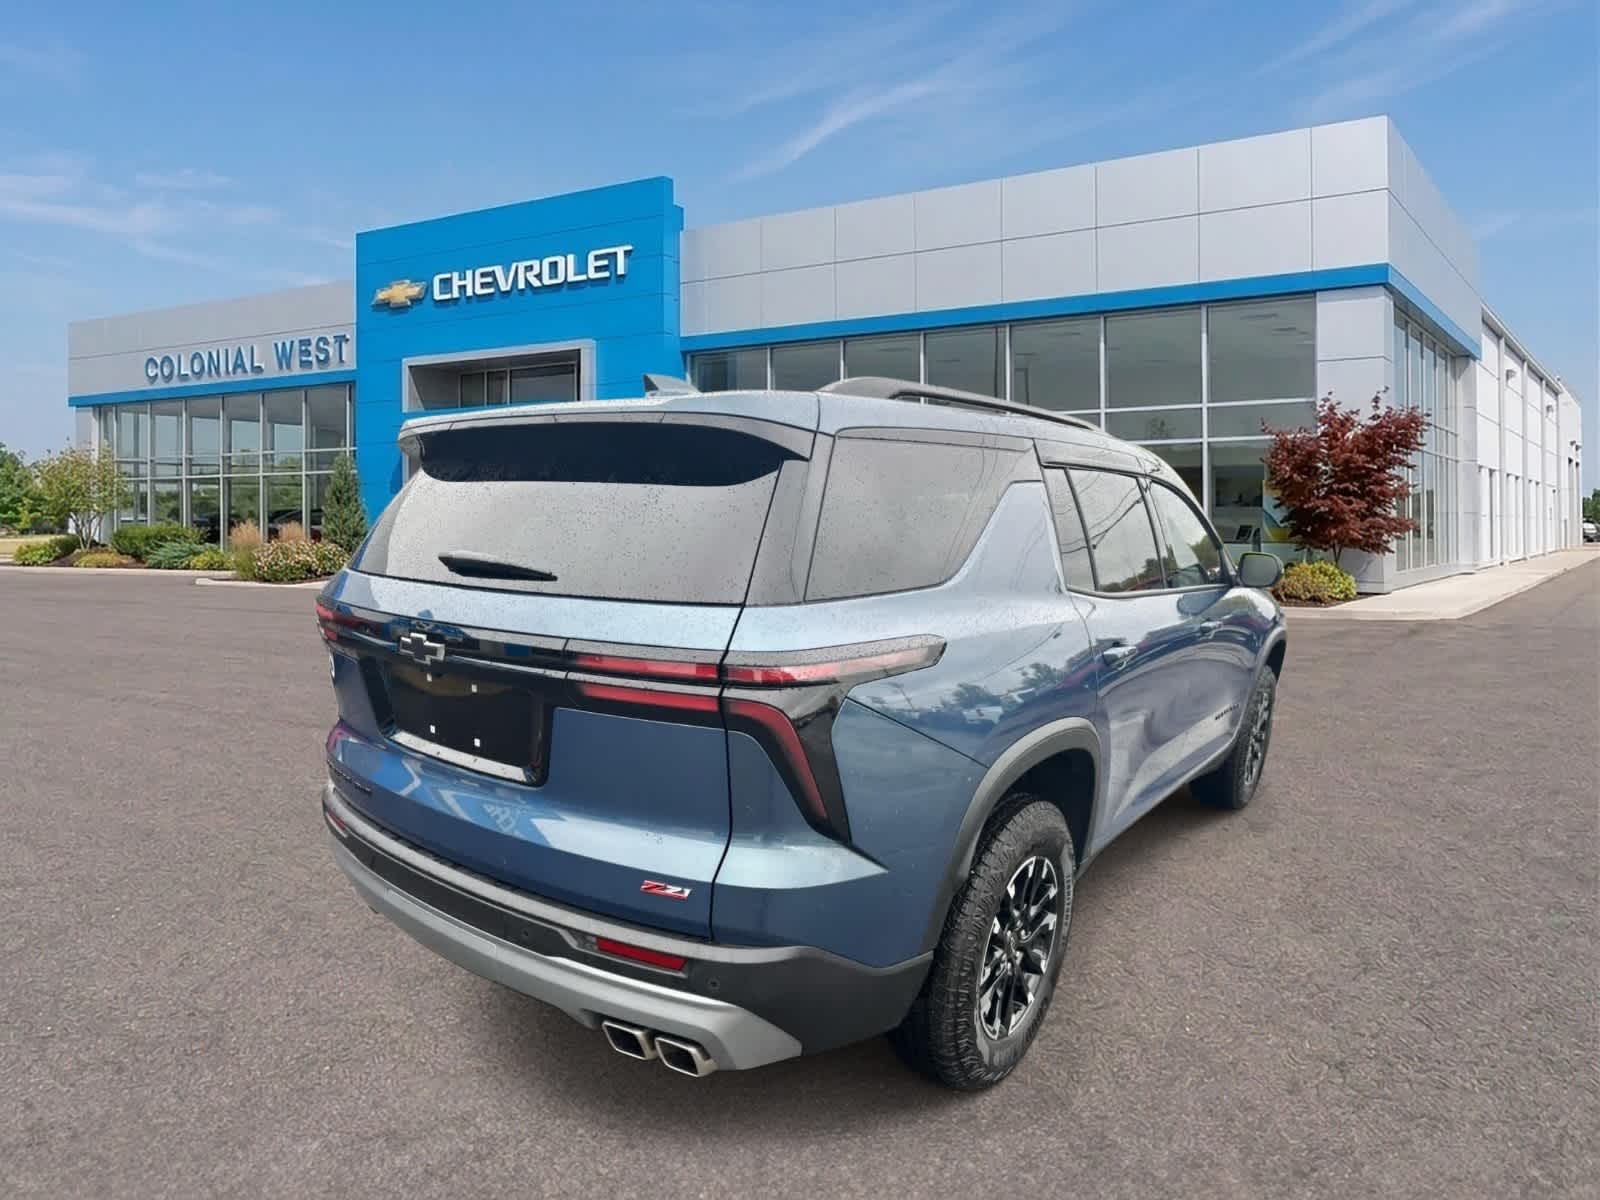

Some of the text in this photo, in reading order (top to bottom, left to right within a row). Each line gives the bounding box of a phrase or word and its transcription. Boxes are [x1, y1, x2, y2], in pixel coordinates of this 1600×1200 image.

[433, 244, 633, 301] CHEVROLET
[145, 334, 349, 381] COLONIAL WEST
